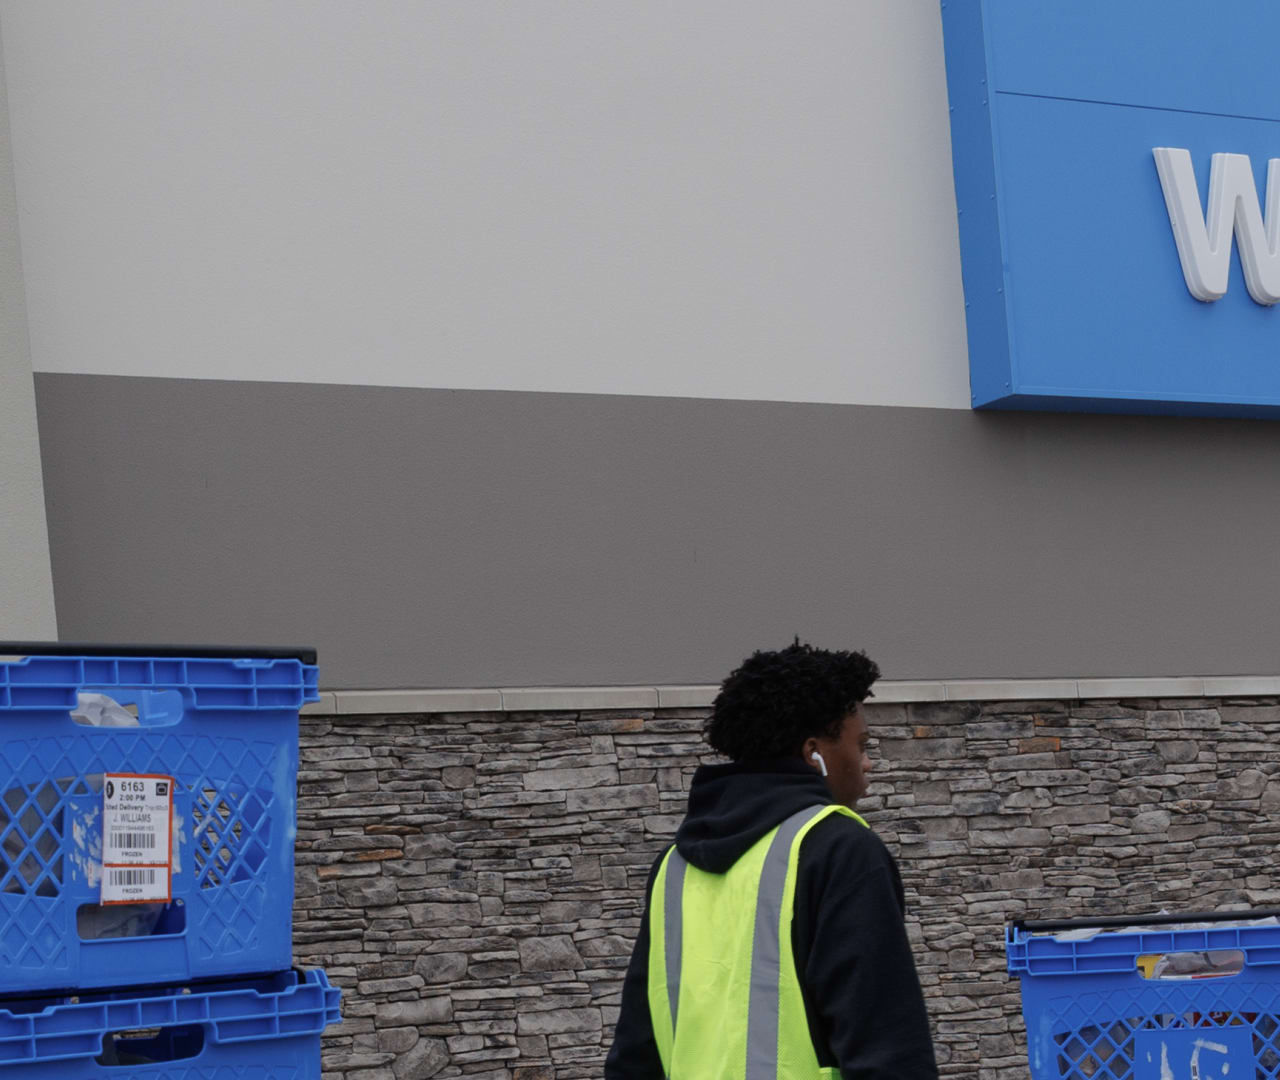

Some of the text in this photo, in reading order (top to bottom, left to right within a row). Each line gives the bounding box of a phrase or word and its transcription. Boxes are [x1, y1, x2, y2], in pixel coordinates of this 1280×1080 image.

[121, 782, 144, 792] 6163
[119, 804, 144, 812] Delivery
[121, 814, 151, 822] WILLIAMS
